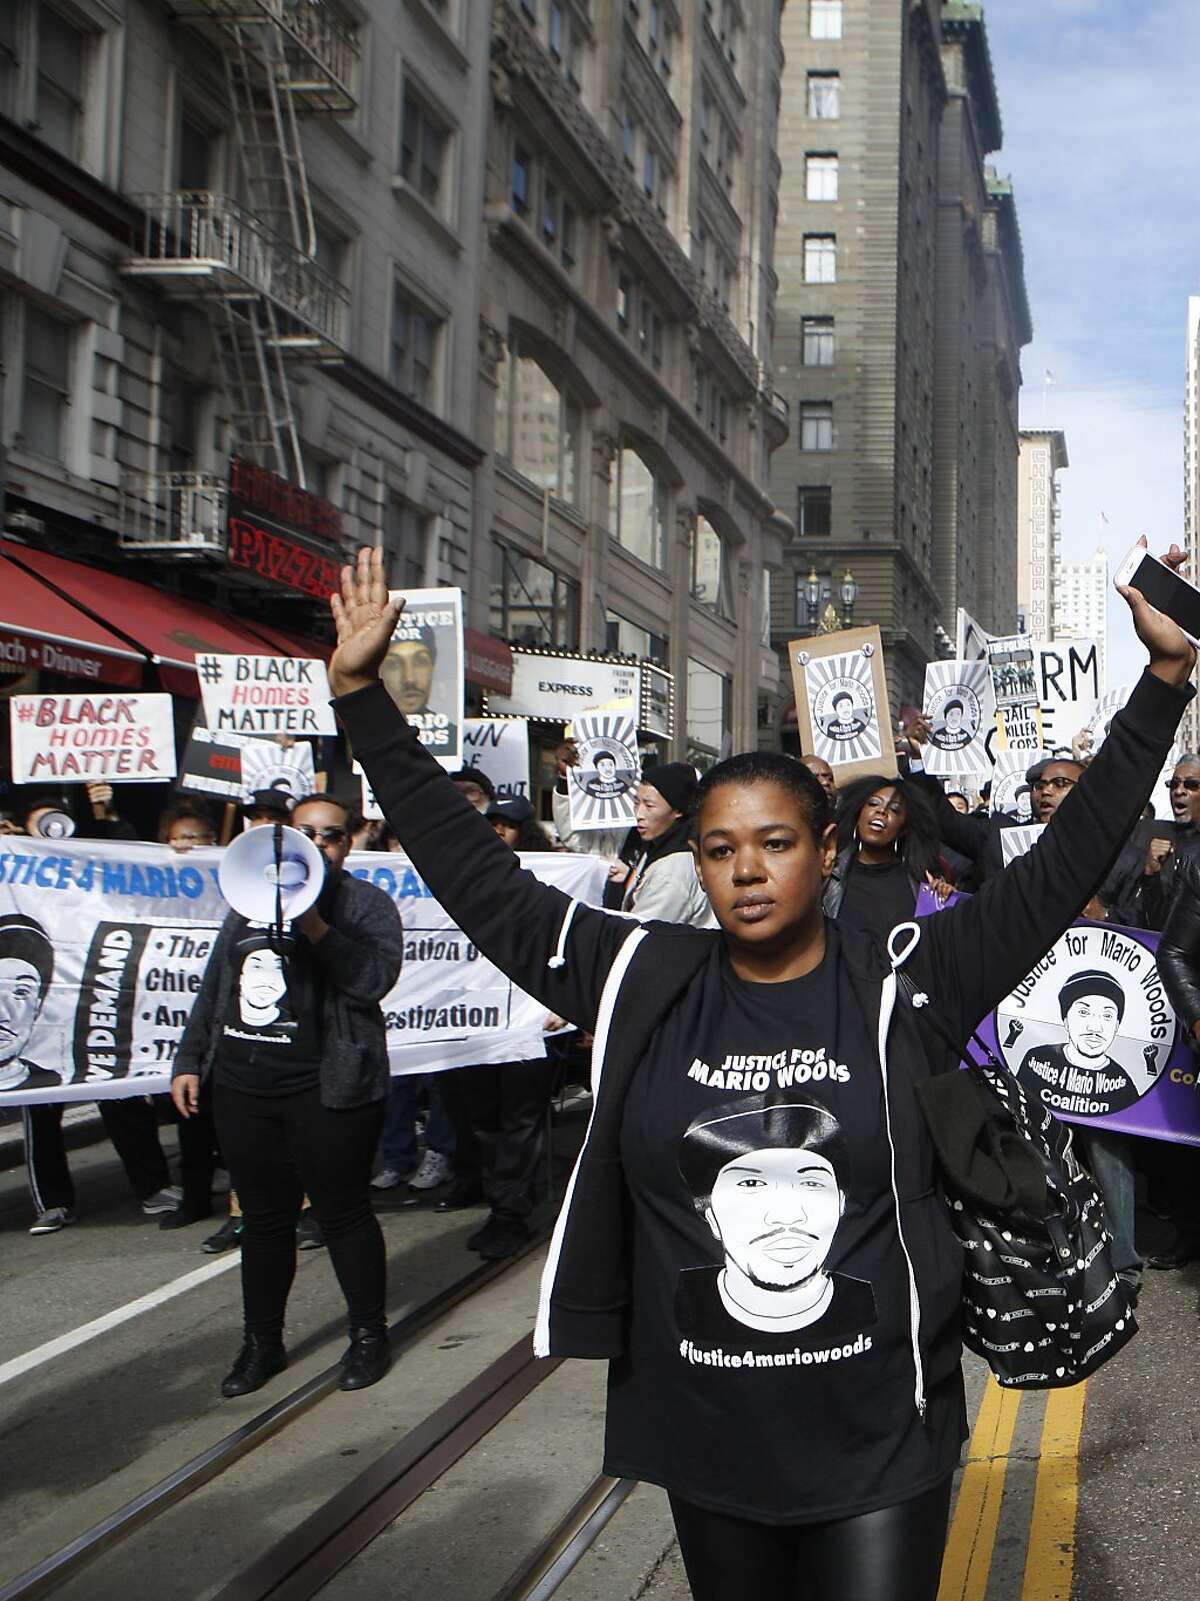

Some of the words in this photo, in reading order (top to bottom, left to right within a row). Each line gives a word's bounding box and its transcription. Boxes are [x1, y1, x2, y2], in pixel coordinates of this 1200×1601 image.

[396, 610, 454, 627] TICE
[42, 643, 102, 677] Dinner
[236, 657, 312, 684] BLACK
[231, 685, 309, 706] HOMES
[538, 682, 593, 696] EXPRESS
[18, 697, 138, 727] #BLACK
[218, 708, 319, 730] MATTER
[1005, 706, 1030, 722] JAIL
[50, 726, 151, 748] HOMES
[1005, 722, 1037, 738] KILLER
[1010, 736, 1038, 749] COPS
[29, 749, 160, 777] MATTER
[102, 862, 204, 899] MARIO
[169, 934, 210, 958] The
[86, 929, 134, 1047] DEMAND
[1065, 933, 1088, 957] for
[1100, 931, 1142, 972] Mario
[1140, 965, 1173, 1039] Woods
[721, 1051, 787, 1071] JUSTICE
[791, 1048, 826, 1064] FOR
[687, 1058, 770, 1092] MARIO
[1028, 1056, 1058, 1085] Justice
[1059, 1067, 1066, 1088] 4
[1066, 1067, 1093, 1094] Mario
[1094, 1072, 1127, 1094] Woods
[1040, 1088, 1110, 1113] Coalition
[679, 1334, 873, 1368] #justice4mariowoods
